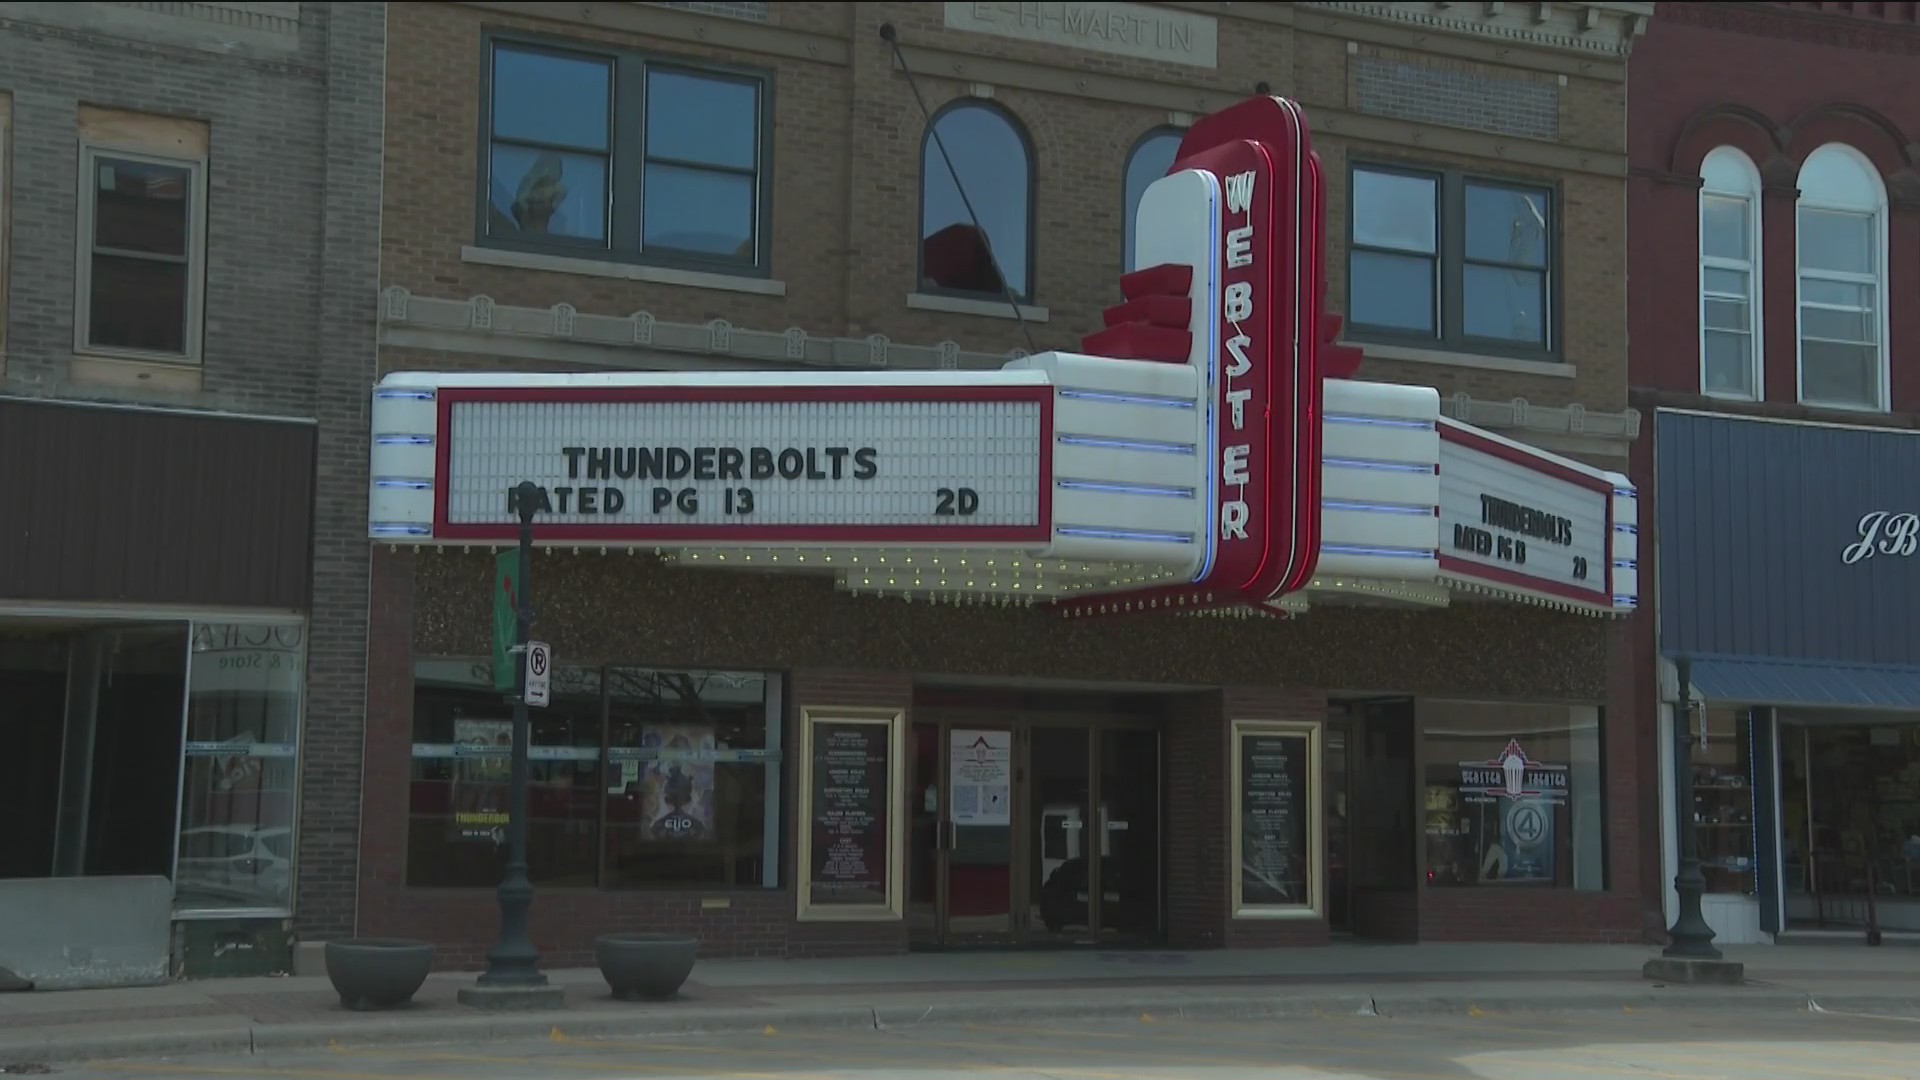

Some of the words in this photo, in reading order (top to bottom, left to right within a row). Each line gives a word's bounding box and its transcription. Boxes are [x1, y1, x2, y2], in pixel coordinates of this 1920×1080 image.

[1222, 170, 1256, 541] WEBSTER
[563, 447, 877, 481] THUNDERBOLTS
[653, 487, 697, 515] PG
[725, 488, 754, 515] 13
[935, 488, 978, 515] 2D
[1480, 493, 1572, 547] THUNDERBOLTS
[1453, 523, 1493, 556] RATED
[1497, 535, 1513, 562] PG
[1515, 540, 1526, 564] 13
[1517, 810, 1538, 838] 4
